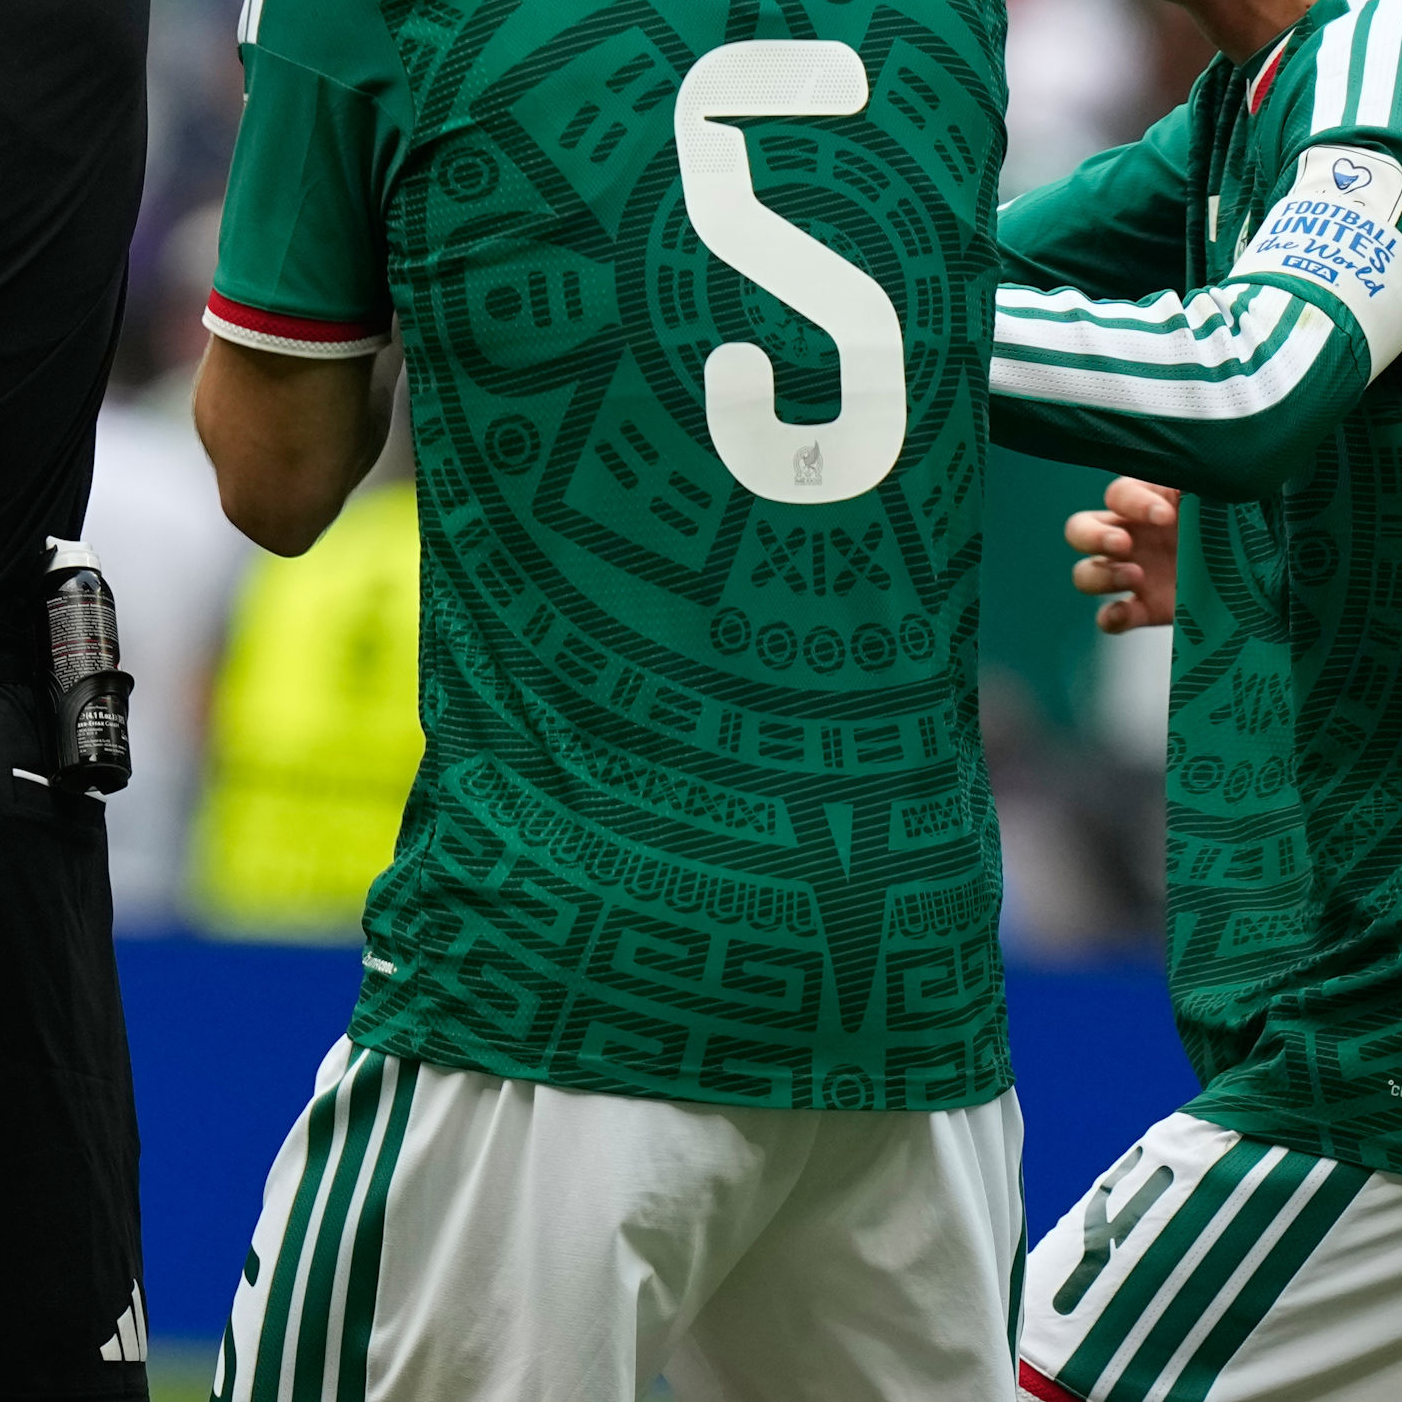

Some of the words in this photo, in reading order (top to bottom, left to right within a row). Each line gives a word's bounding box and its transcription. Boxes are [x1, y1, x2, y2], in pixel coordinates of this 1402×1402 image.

[1270, 216, 1391, 274] UNITES
[1281, 200, 1396, 258] FOOTBALL
[674, 39, 907, 504] 5
[1256, 236, 1300, 254] the
[1304, 238, 1386, 298] World
[1282, 255, 1339, 284] FIFA
[1052, 1145, 1175, 1316] 4
